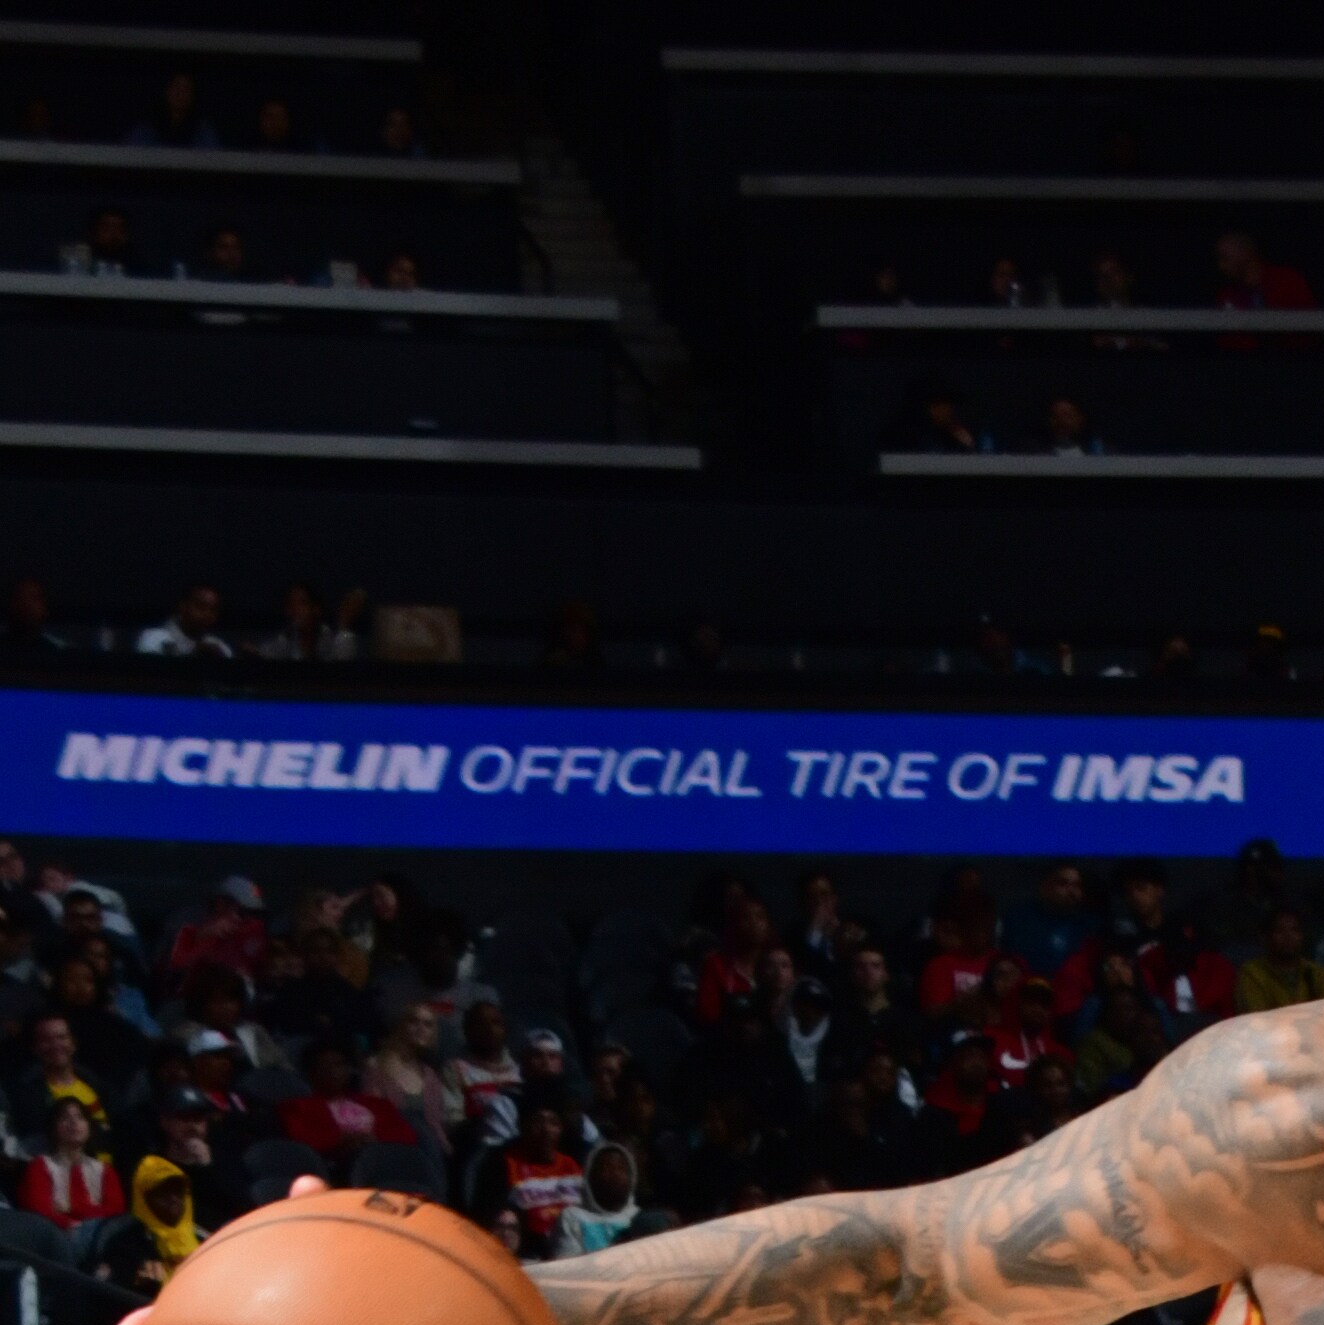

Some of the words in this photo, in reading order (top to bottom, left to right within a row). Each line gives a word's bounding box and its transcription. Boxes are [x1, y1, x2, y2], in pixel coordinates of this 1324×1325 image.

[56, 732, 450, 793] MICHELIN
[459, 745, 763, 798] OFFICIAL
[786, 750, 939, 800] TIRE
[947, 753, 1047, 801] OF
[1051, 754, 1246, 802] IMSA
